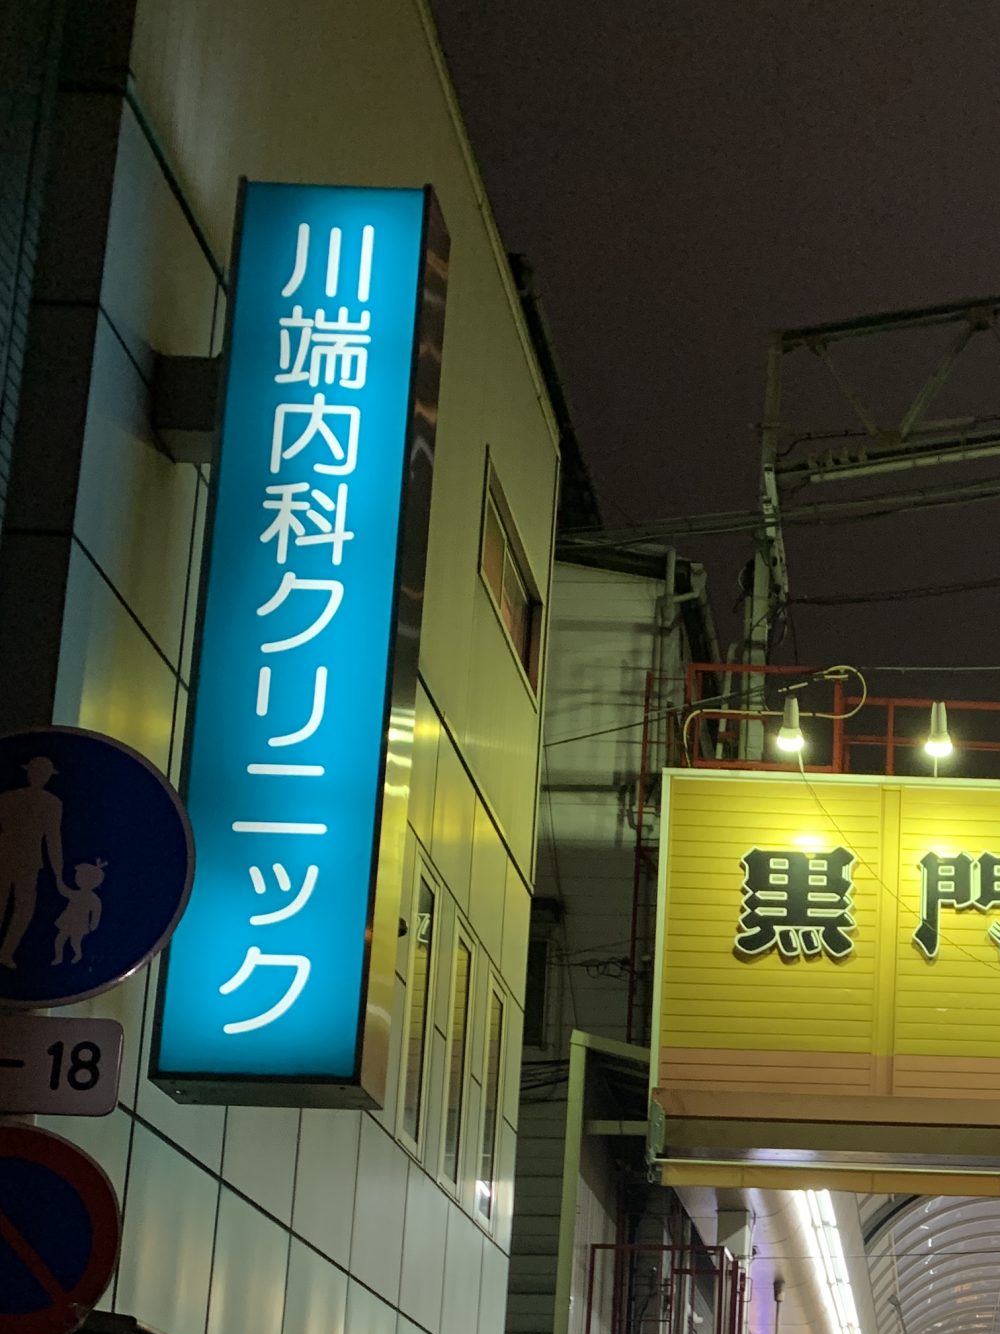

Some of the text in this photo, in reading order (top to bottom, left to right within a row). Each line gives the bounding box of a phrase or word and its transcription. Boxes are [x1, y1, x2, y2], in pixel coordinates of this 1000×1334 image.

[219, 222, 375, 1035] 川端内科クリニック
